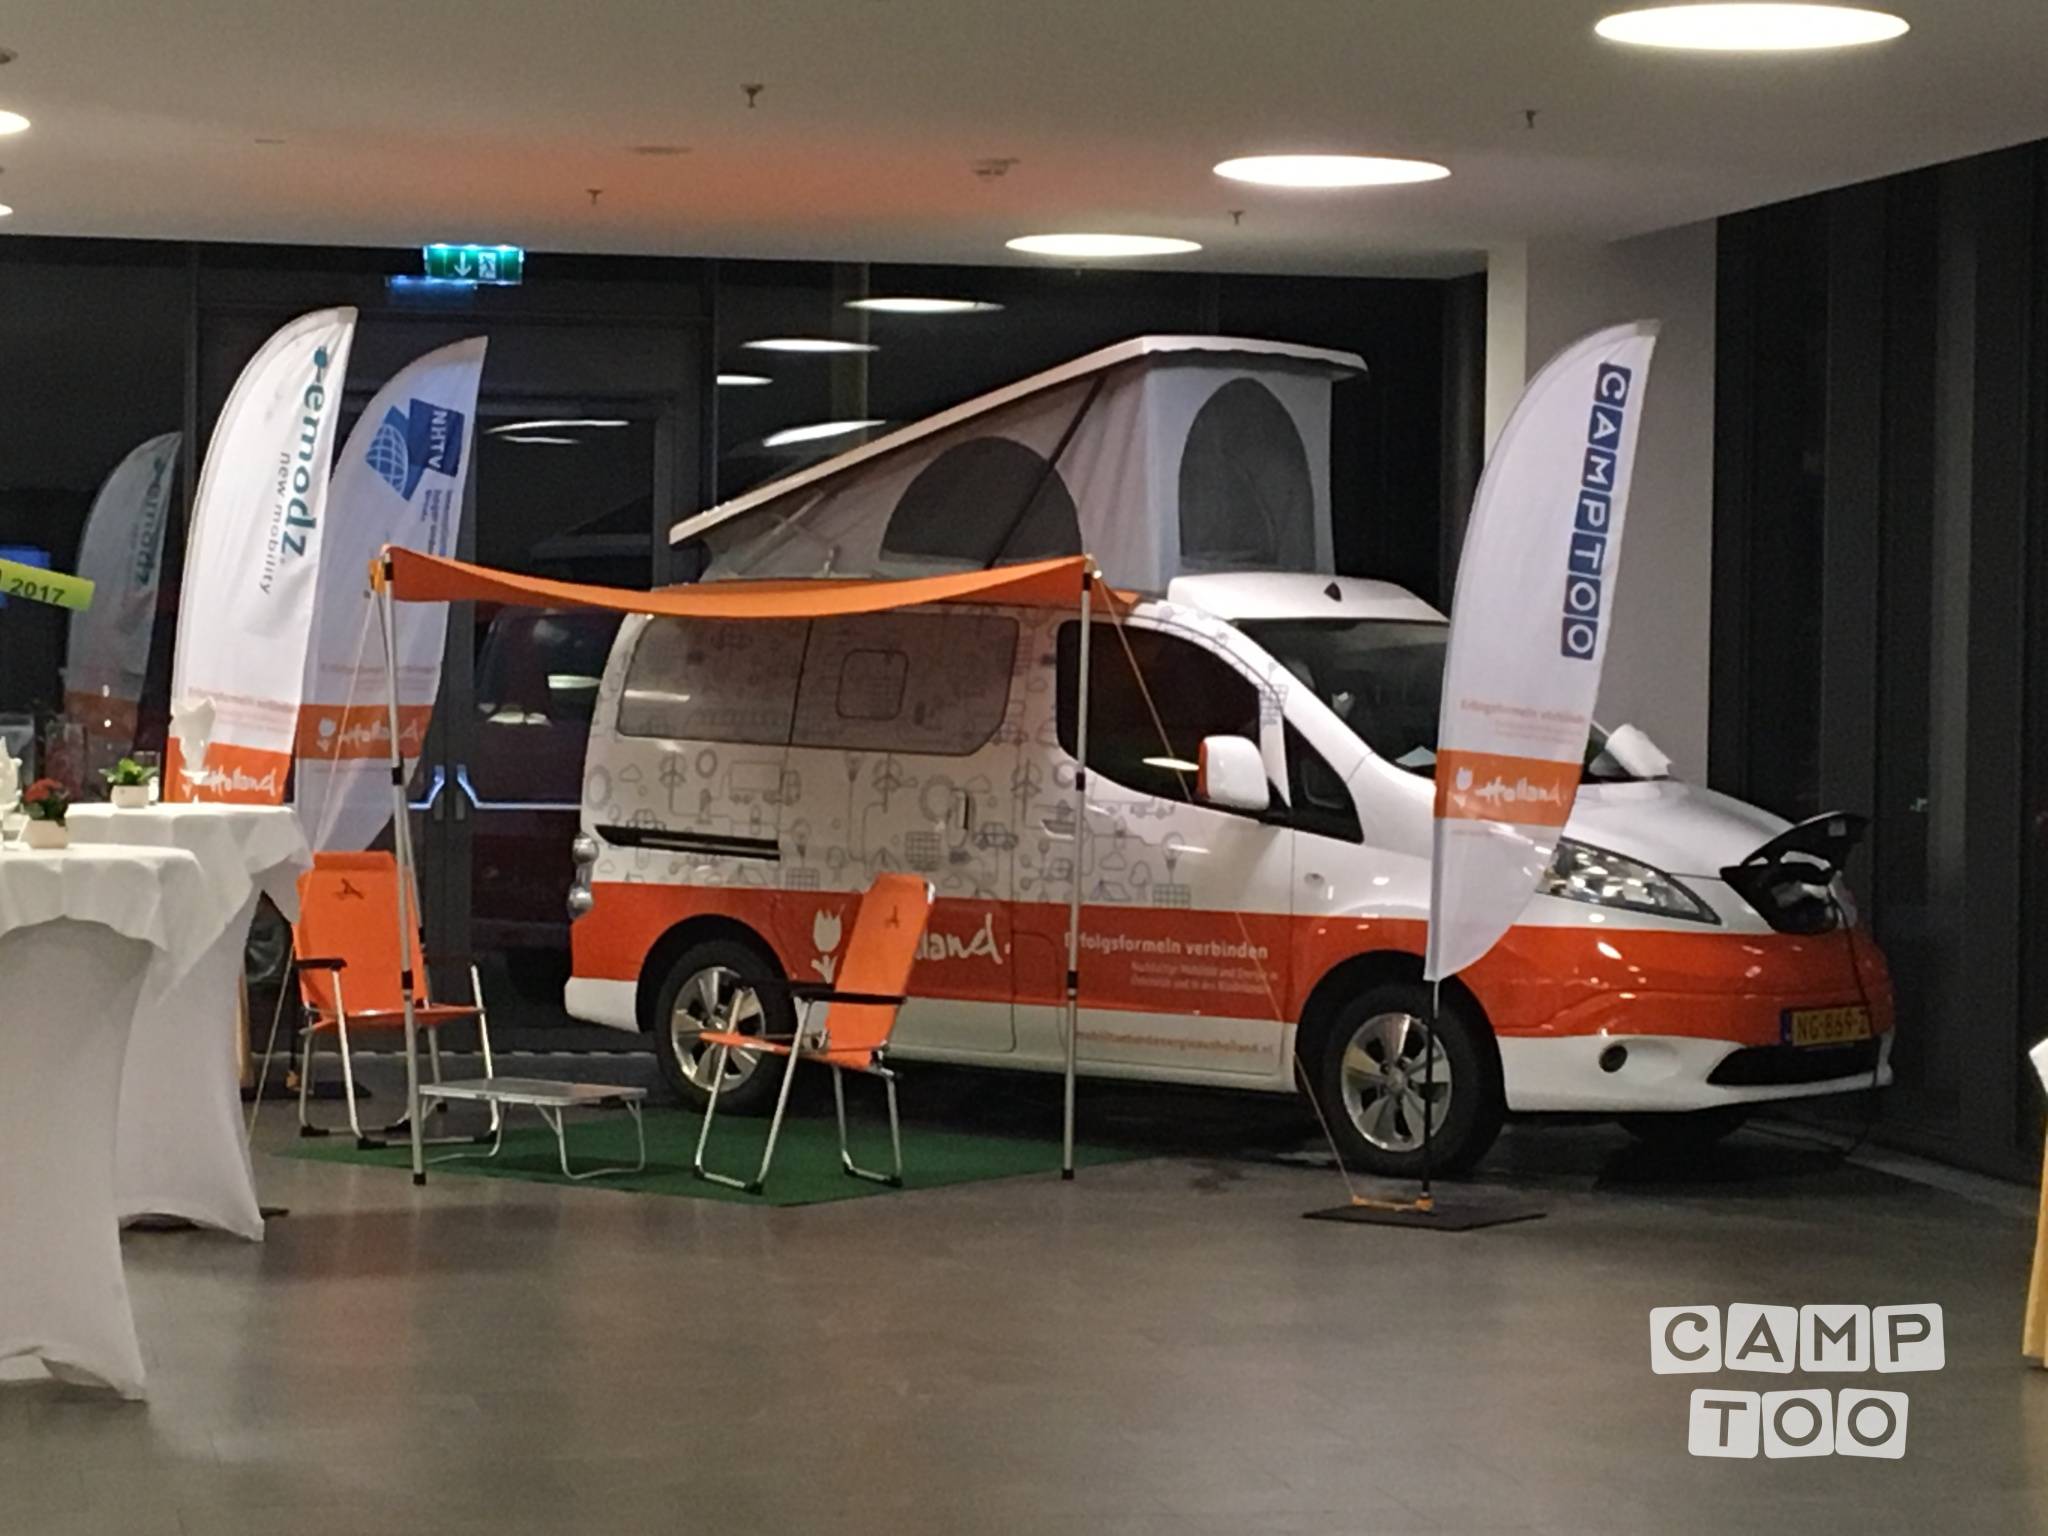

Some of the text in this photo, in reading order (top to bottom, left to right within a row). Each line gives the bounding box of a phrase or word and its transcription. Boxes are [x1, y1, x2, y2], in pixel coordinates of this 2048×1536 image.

[281, 383, 325, 557] emodz
[427, 410, 448, 469] NHTV
[260, 452, 290, 594] new mobility
[1565, 370, 1628, 655] CAMPTOO
[10, 578, 65, 603] 2017
[1064, 931, 1268, 959] Efolgsformeln verbinden
